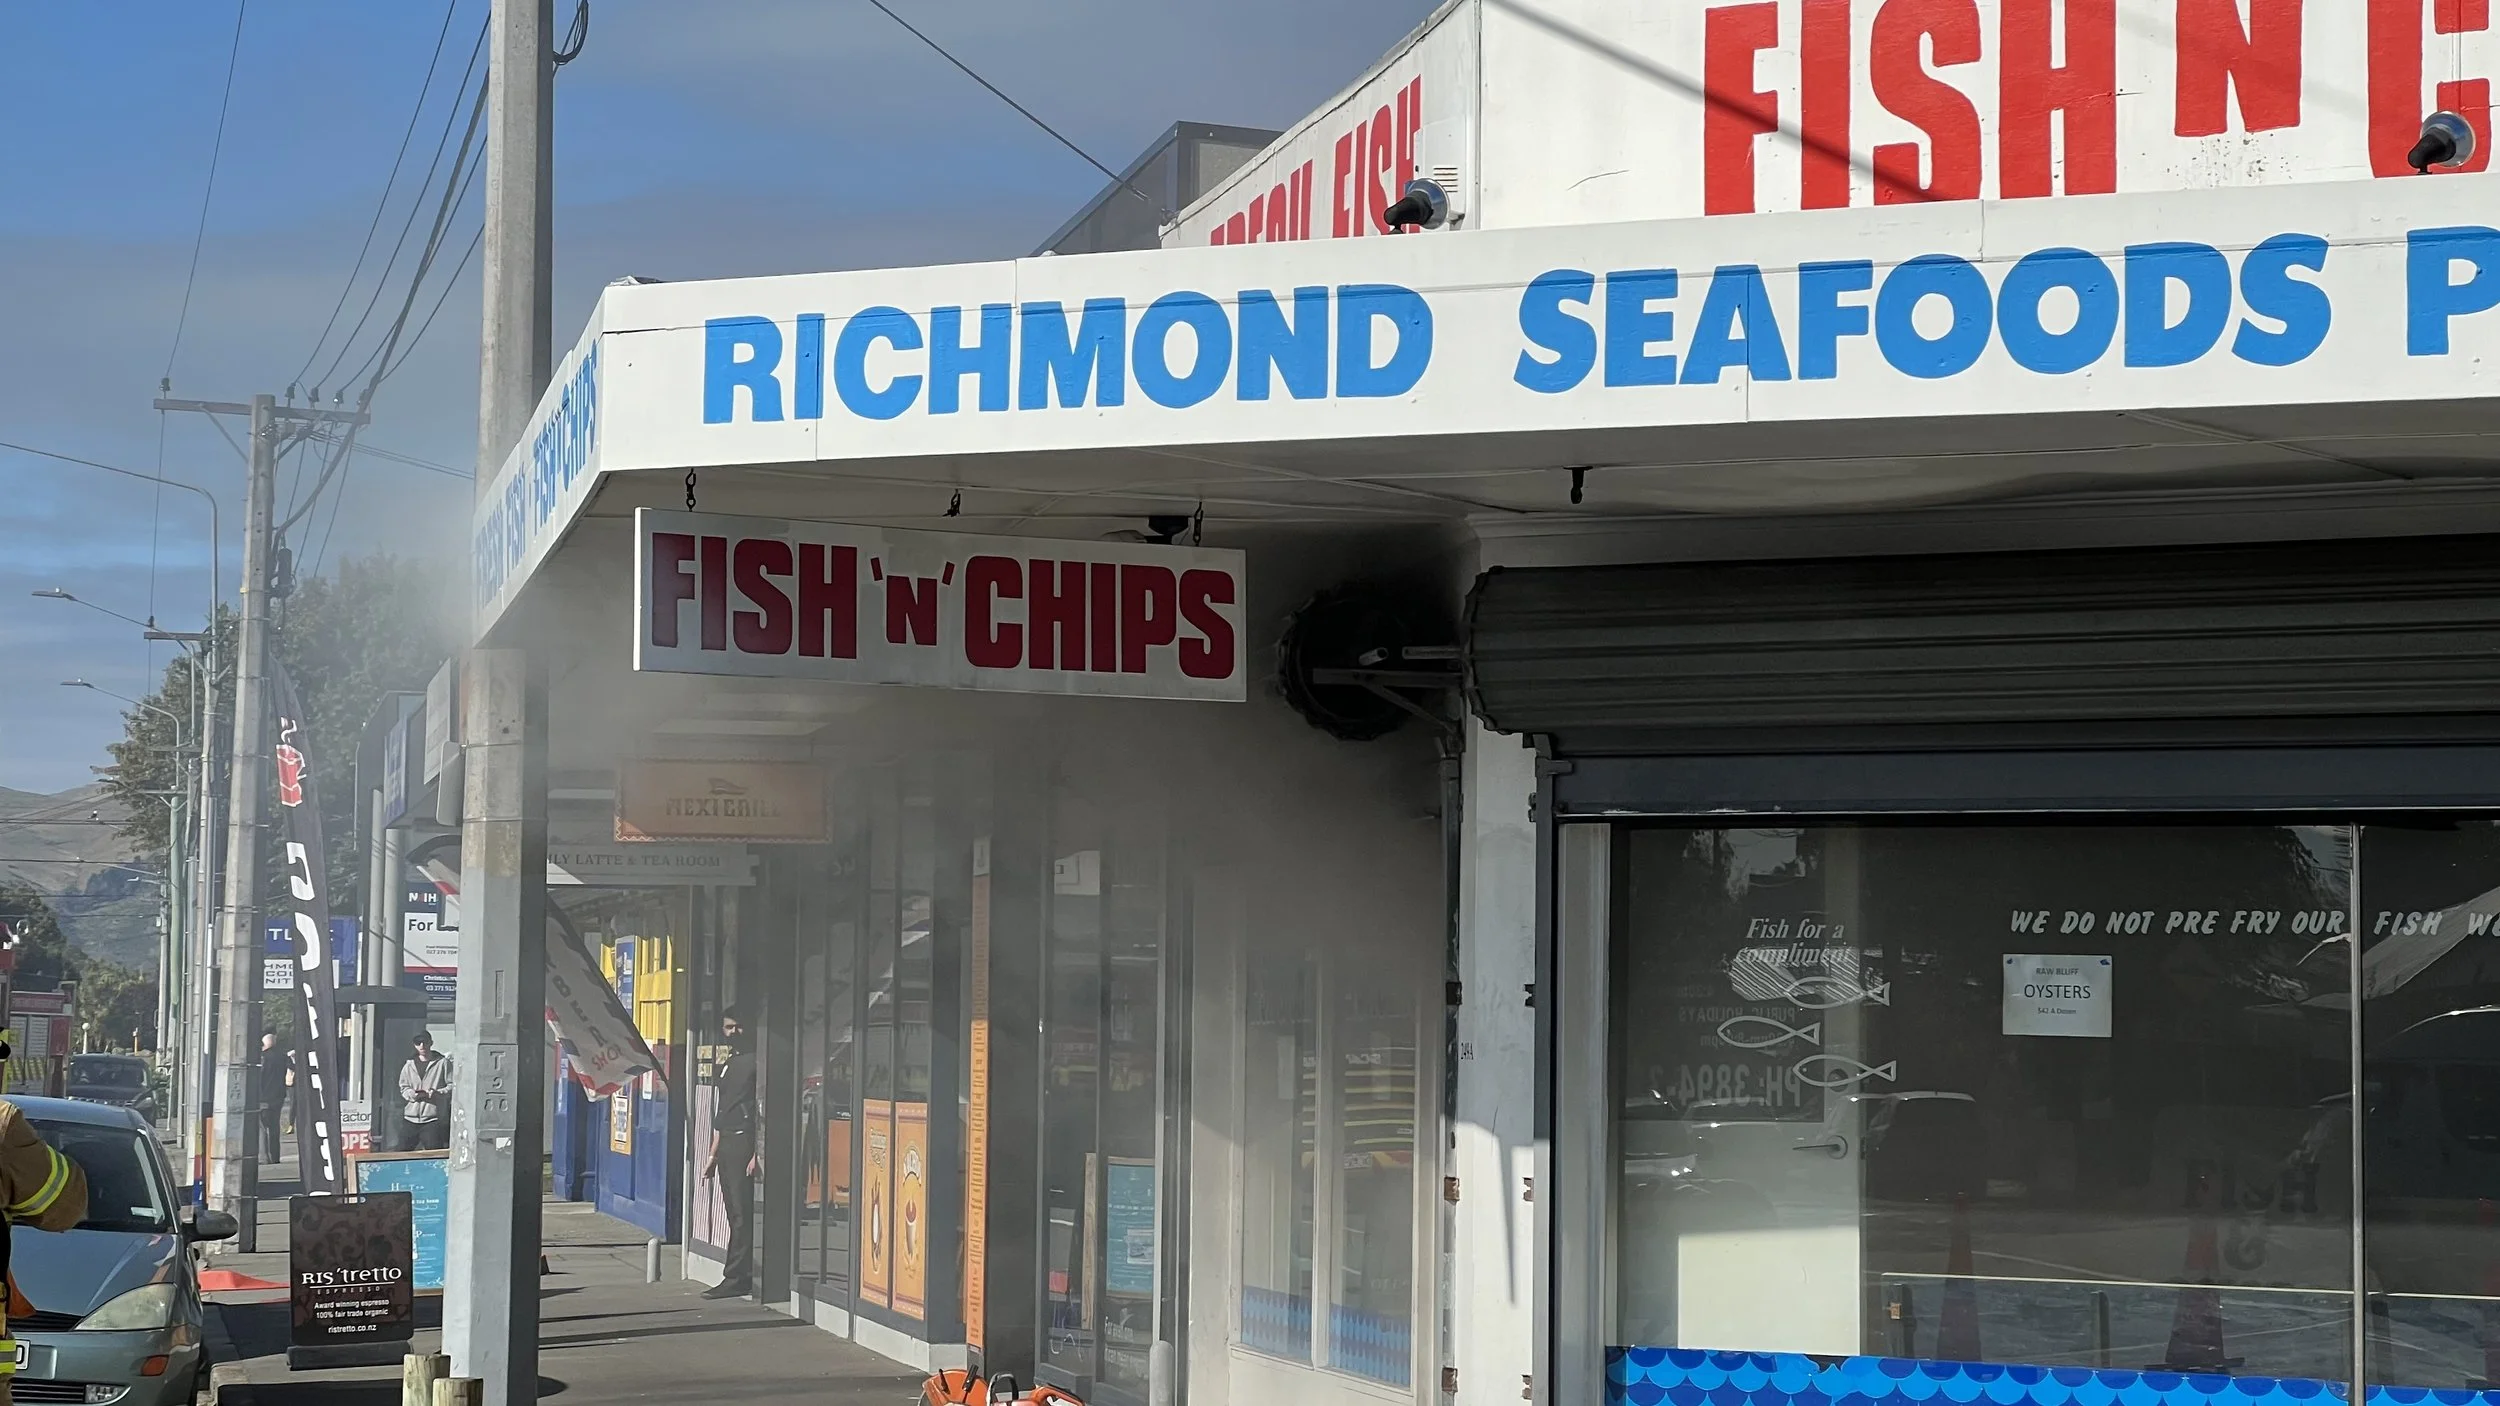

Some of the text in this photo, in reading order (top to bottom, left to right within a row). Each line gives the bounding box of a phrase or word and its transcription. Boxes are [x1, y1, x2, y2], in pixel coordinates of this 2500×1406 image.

[1704, 0, 2117, 216] FISH
[1333, 74, 1421, 239] FISH
[703, 284, 1433, 424] RICHMOND
[1514, 233, 2331, 393] SEAFOODS
[652, 532, 1235, 680] FISH 'N' CHIPS
[576, 854, 623, 865] LATTE
[641, 855, 671, 866] TEA
[676, 855, 721, 867] ROOM
[409, 918, 433, 932] For
[1745, 917, 1846, 940] Fish for a
[2010, 911, 2048, 934] WE
[2060, 911, 2096, 935] DO
[2105, 911, 2153, 935] NOT
[2165, 911, 2218, 935] PRE
[2229, 911, 2281, 935] FRY
[2290, 911, 2343, 935] OUR
[2373, 911, 2443, 936] FISH
[2035, 967, 2080, 976] RAW BLUFF
[2024, 984, 2092, 999] OYSTERS
[317, 1286, 381, 1295] ESPRESSO
[314, 1299, 390, 1310] Award winning espresso
[316, 1308, 389, 1319] 100% fair trade organic
[328, 1324, 377, 1334] ristretto.co.nz
